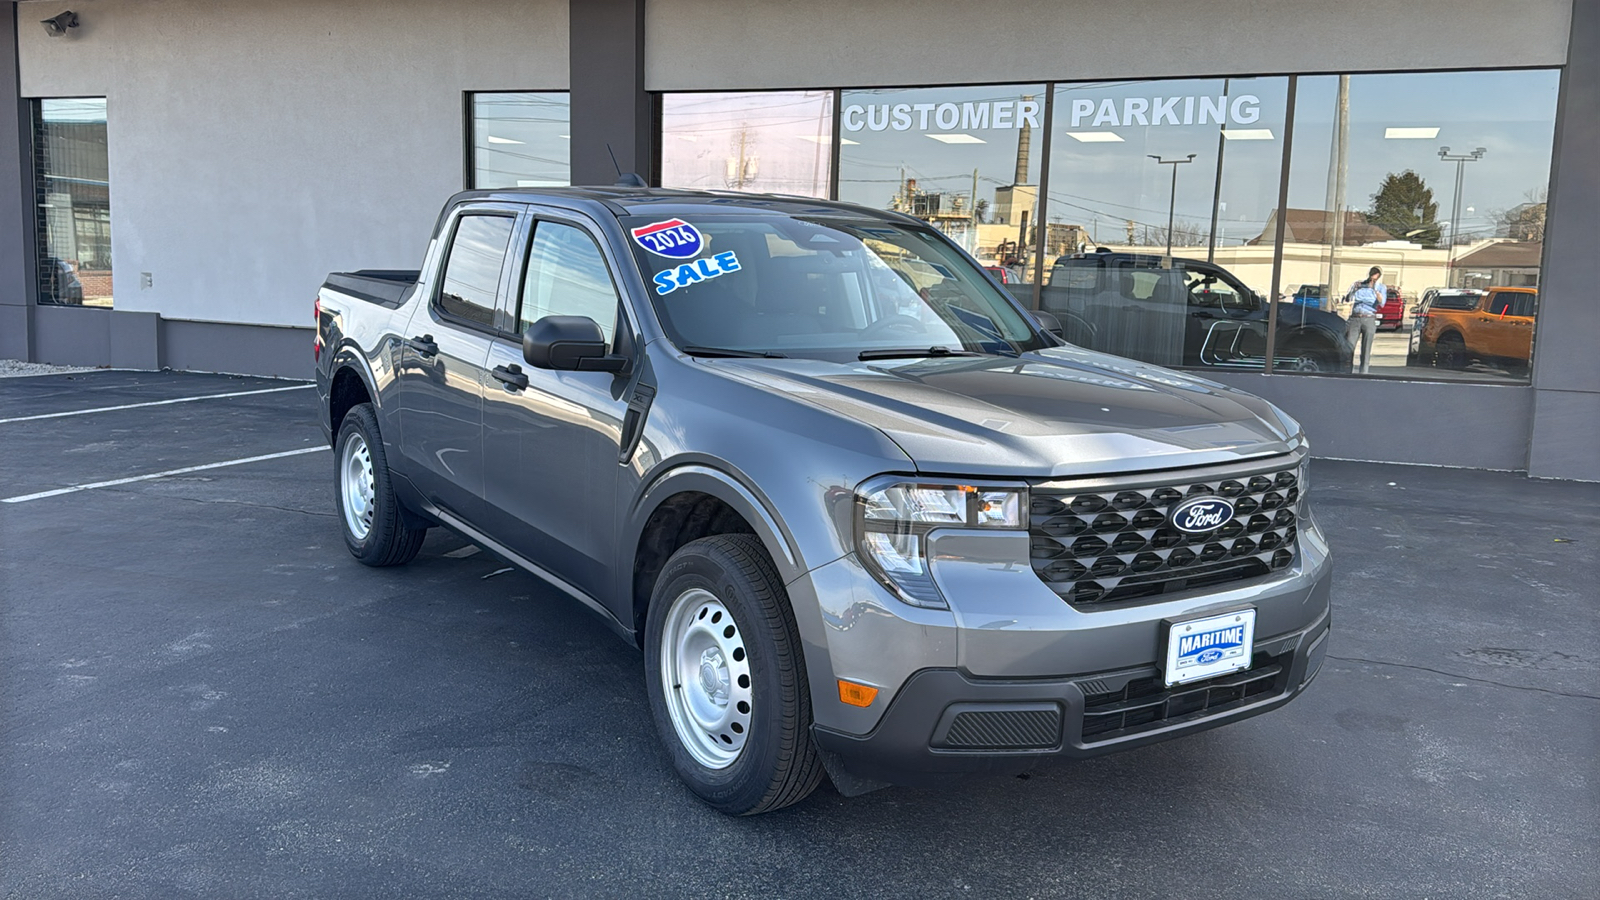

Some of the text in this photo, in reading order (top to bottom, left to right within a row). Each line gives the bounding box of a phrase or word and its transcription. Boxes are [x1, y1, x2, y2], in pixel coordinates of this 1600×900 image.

[843, 95, 1261, 132] CUSTOMER PARKING
[644, 226, 696, 251] 2026
[653, 251, 742, 295] SALE
[1185, 503, 1224, 528] Ford
[1179, 626, 1243, 657] MARITIME
[1200, 651, 1220, 663] Ford
